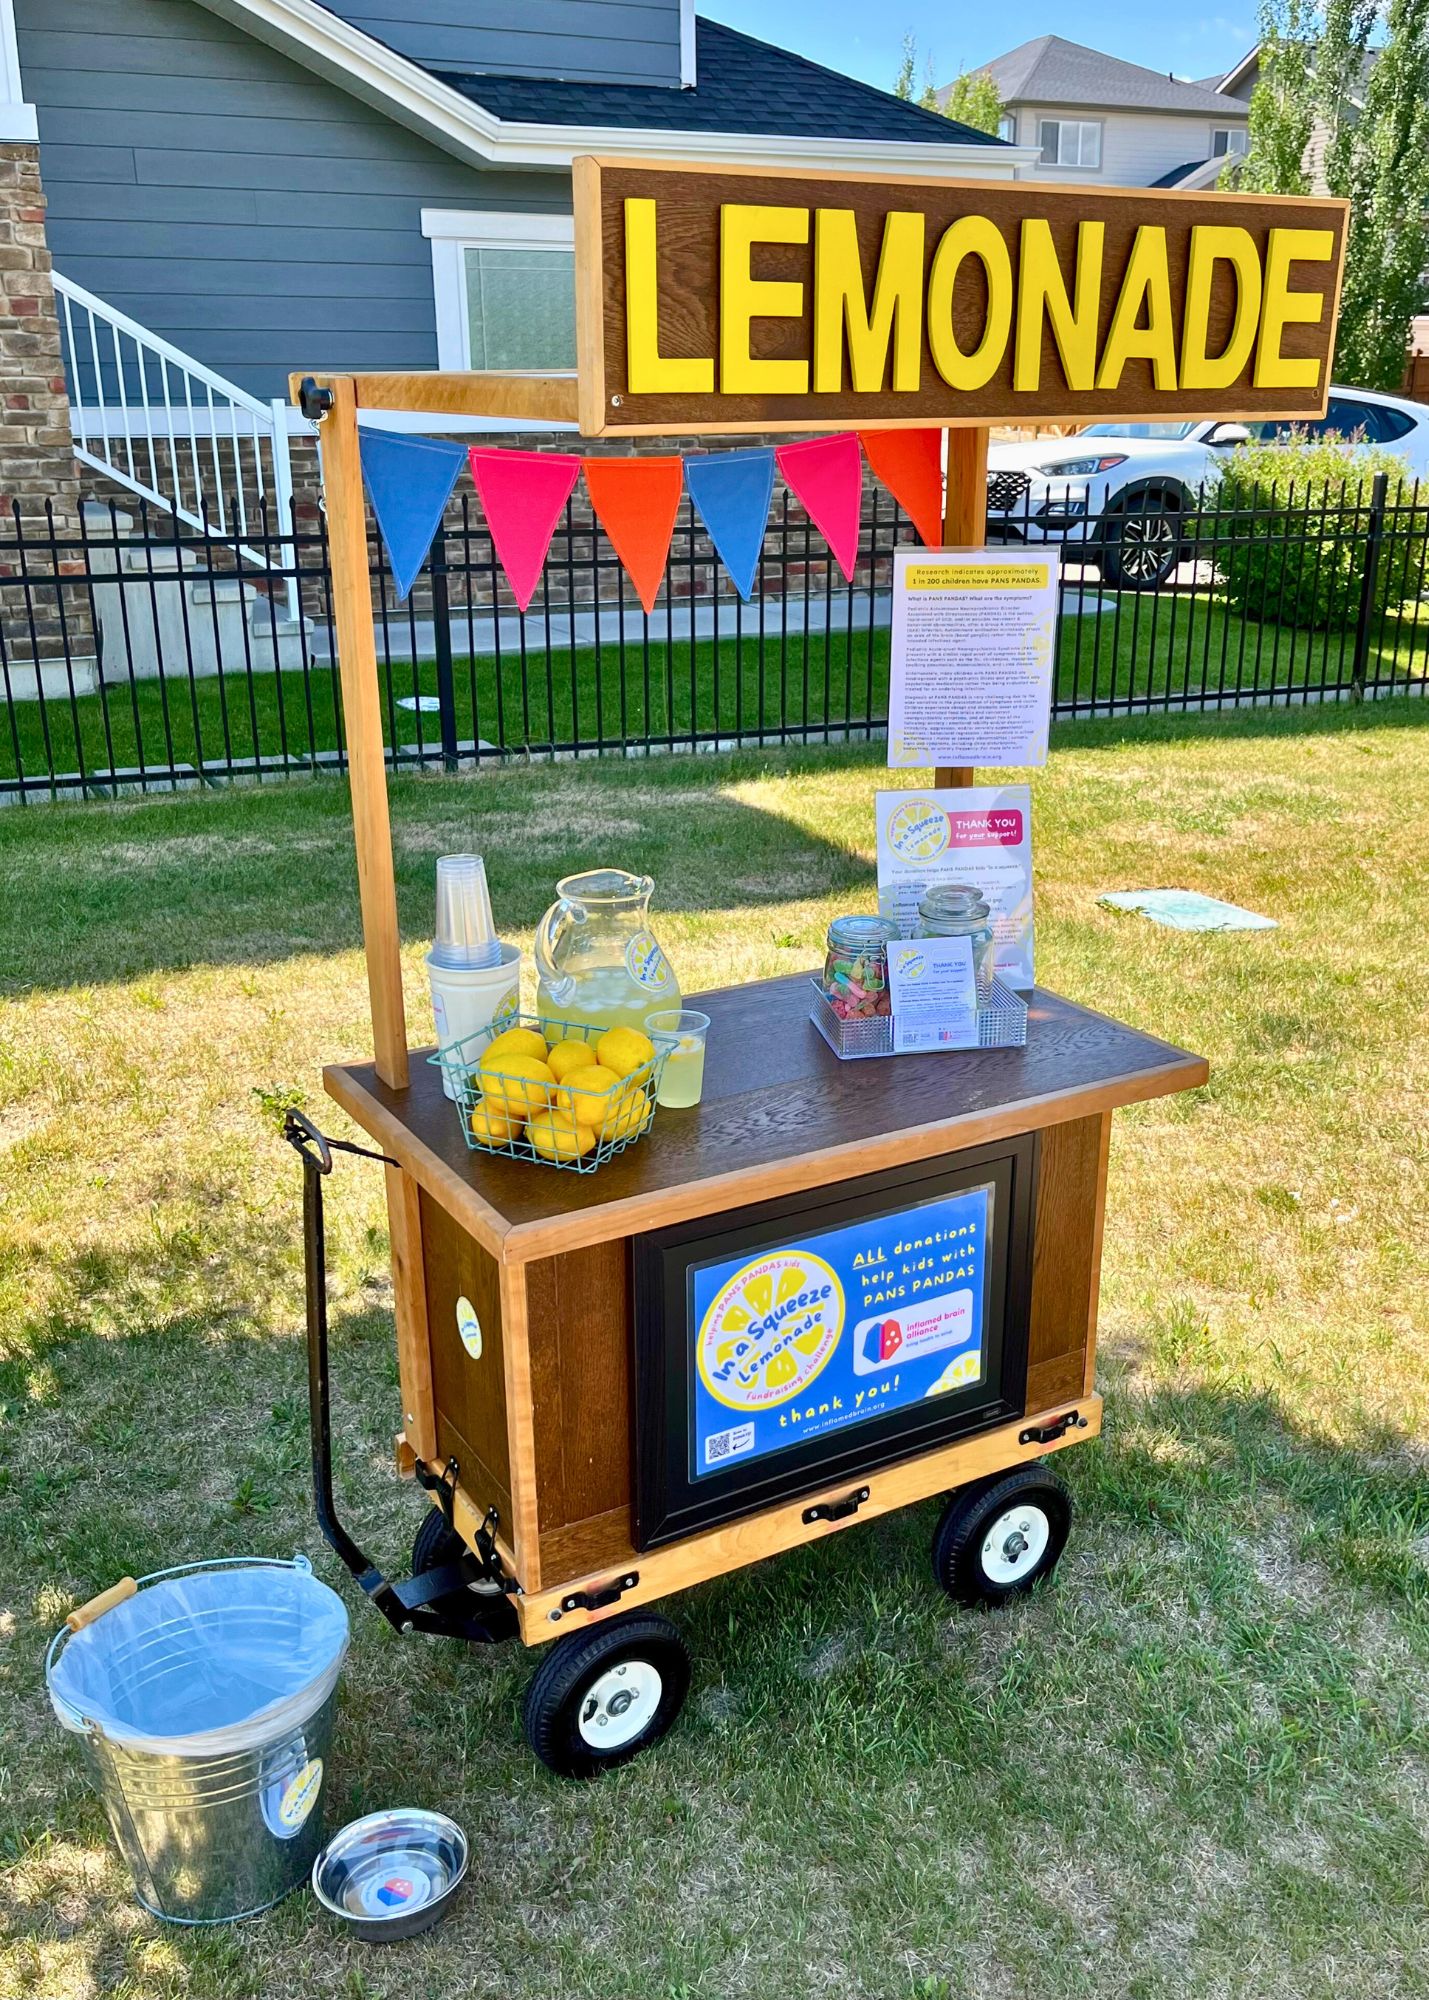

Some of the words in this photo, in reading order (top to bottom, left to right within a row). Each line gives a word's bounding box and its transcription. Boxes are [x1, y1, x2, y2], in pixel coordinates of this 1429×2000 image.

[624, 198, 1333, 394] LEMONADE
[907, 815, 944, 835] Squeeze
[956, 819, 993, 829] THANK
[994, 818, 1016, 828] YOU
[852, 1246, 886, 1268] ALL
[894, 1223, 976, 1255] donations
[861, 1270, 894, 1287] help
[902, 1257, 934, 1274] kids
[942, 1243, 976, 1263] with
[718, 1283, 742, 1312] PANS
[741, 1262, 782, 1287] PANDAS
[864, 1285, 906, 1308] PANS
[912, 1264, 975, 1293] PANDAS
[712, 1360, 736, 1382] In
[735, 1342, 749, 1357] a
[747, 1284, 832, 1341] Squeeze
[906, 1314, 942, 1332] inflamed
[944, 1308, 966, 1320] brain
[906, 1324, 938, 1340] alliance
[738, 1312, 822, 1383] Lemonade
[804, 1327, 834, 1376] challenge
[779, 1395, 843, 1427] thank
[855, 1374, 900, 1408] you!
[802, 1402, 886, 1434] www.inflamedbrain.org
